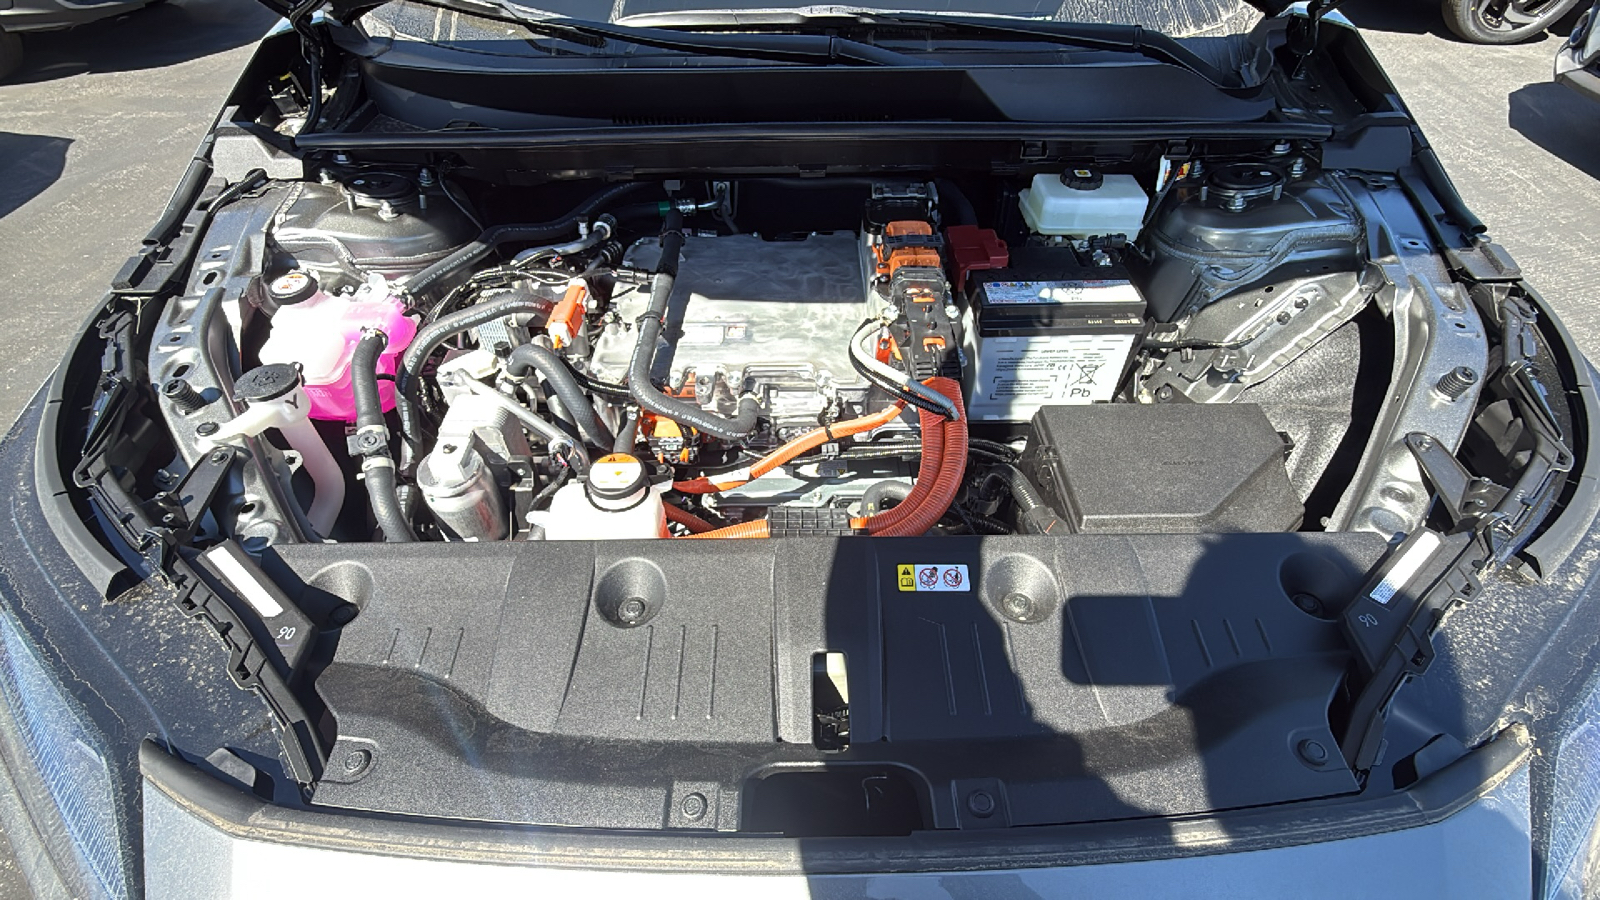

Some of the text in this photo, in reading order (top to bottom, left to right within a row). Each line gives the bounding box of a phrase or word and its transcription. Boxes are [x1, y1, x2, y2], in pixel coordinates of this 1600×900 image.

[1069, 387, 1091, 398] Pb
[1358, 613, 1378, 627] 90
[276, 626, 296, 641] 90
